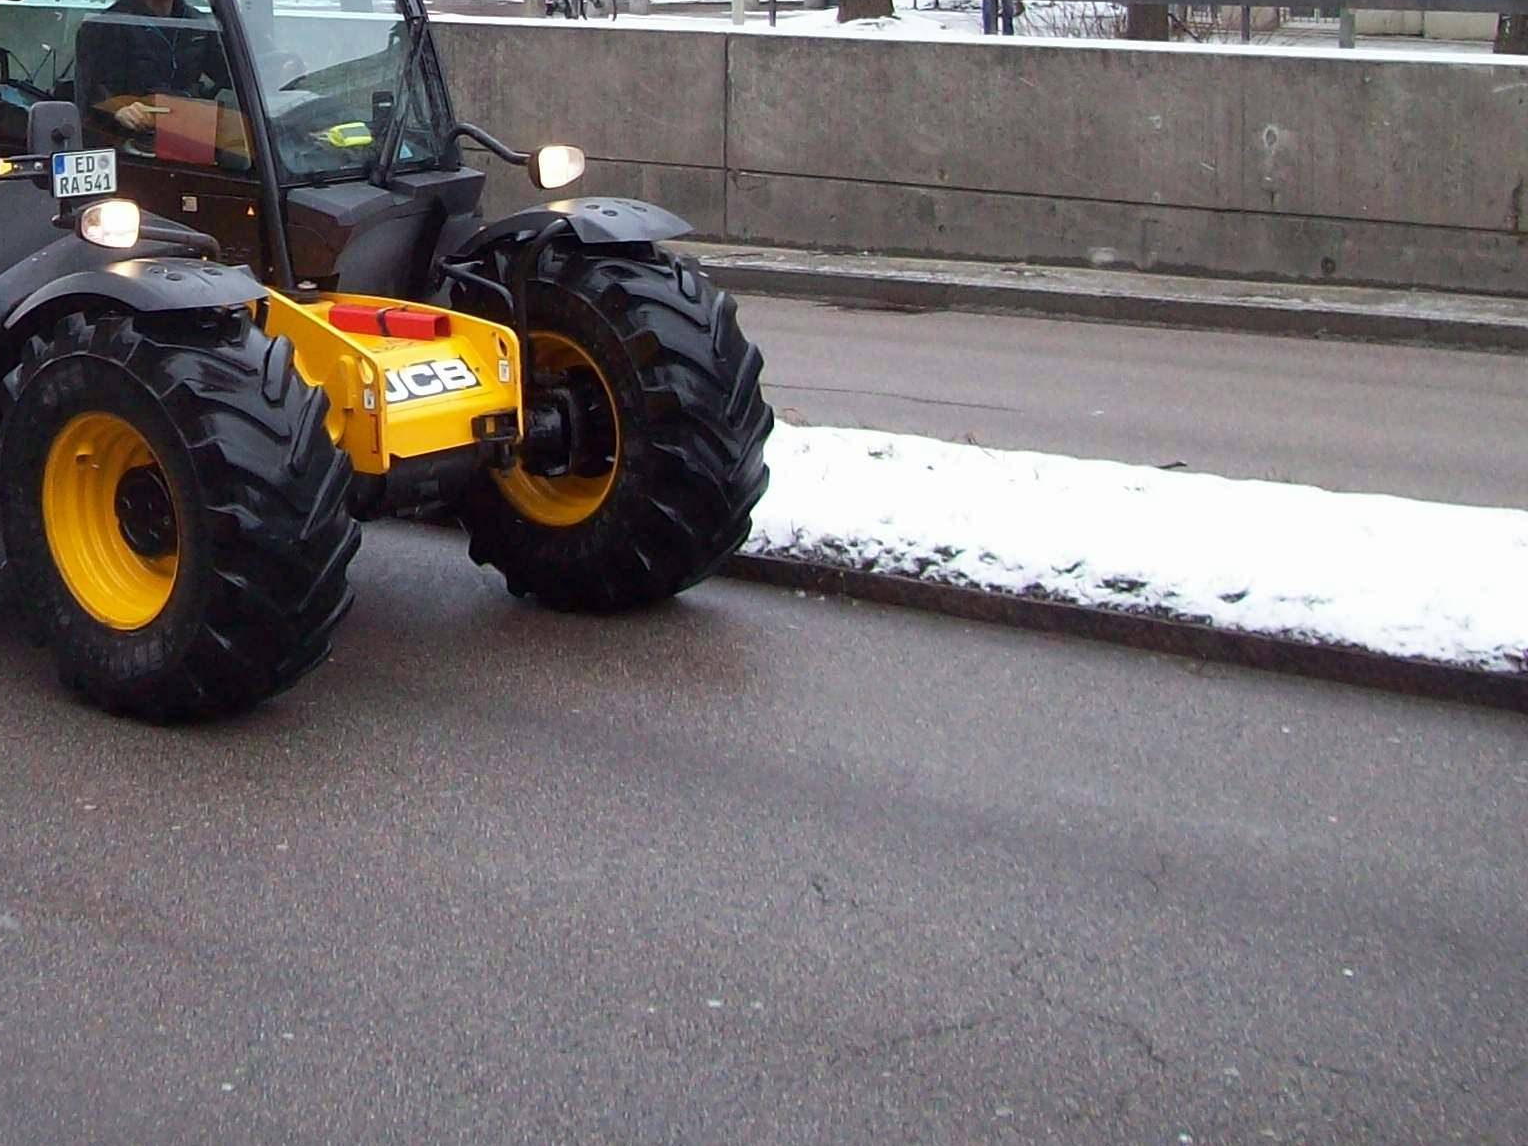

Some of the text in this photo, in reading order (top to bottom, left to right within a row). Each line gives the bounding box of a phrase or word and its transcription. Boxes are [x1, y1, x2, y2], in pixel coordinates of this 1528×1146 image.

[75, 156, 95, 173] ED
[60, 173, 111, 194] RA 541
[385, 358, 477, 403] JCB
